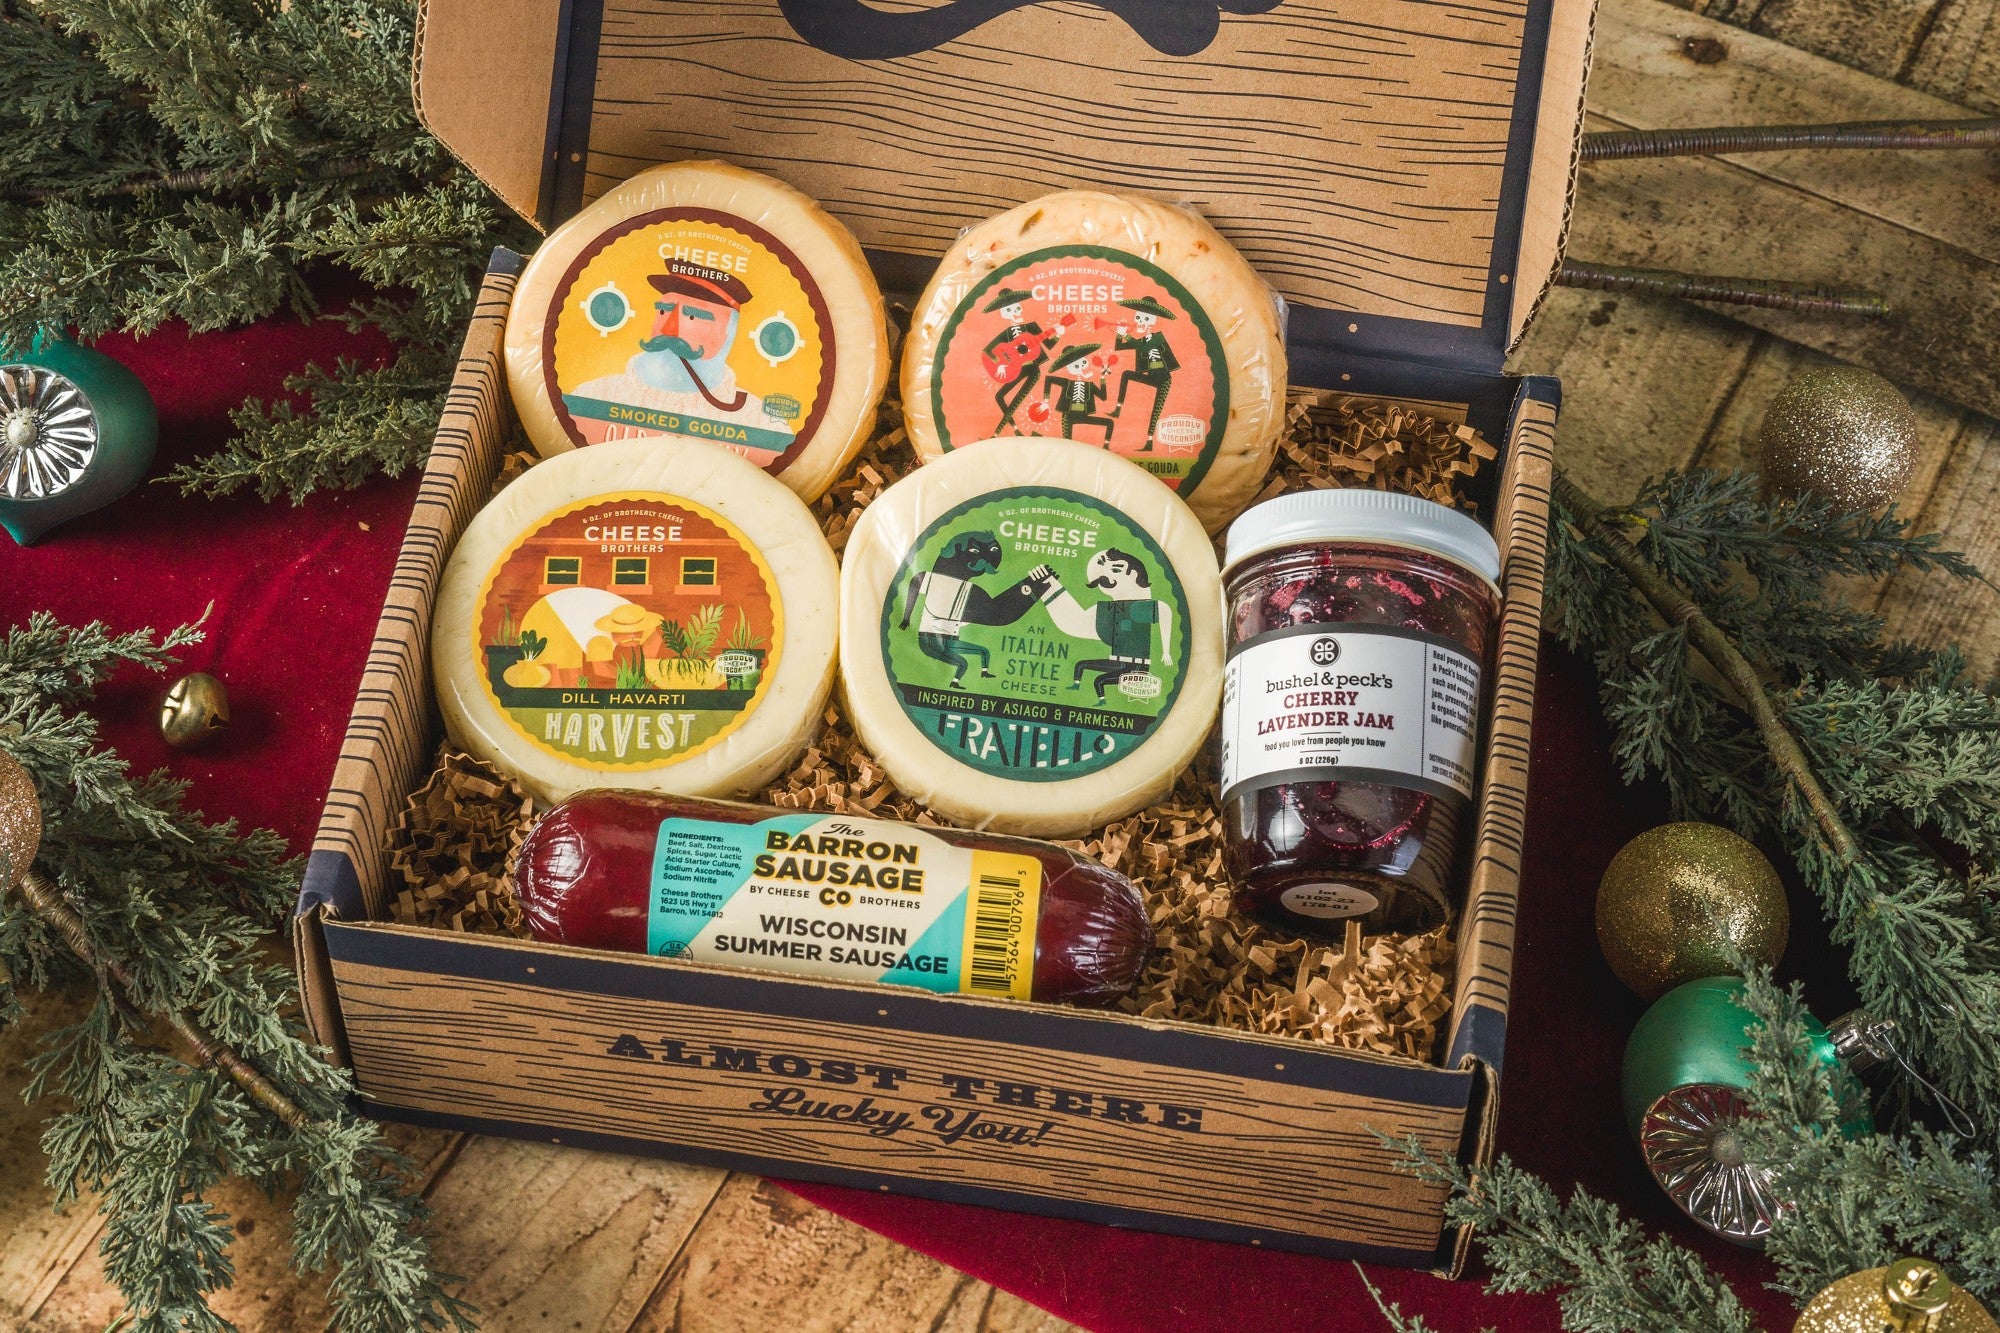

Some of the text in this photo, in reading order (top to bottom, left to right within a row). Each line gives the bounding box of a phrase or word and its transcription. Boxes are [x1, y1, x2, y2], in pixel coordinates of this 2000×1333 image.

[688, 231, 726, 243] BROTHERLY
[728, 240, 752, 255] CHEESE
[658, 243, 748, 272] CHEESE
[672, 265, 729, 281] BROTHERS
[1101, 271, 1125, 282] CHEESE
[1031, 285, 1123, 301] CHEESE
[1048, 304, 1107, 313] BROTHERS
[609, 407, 679, 429] SMOKED
[689, 421, 747, 441] GOUDA
[1162, 433, 1201, 442] WISCONSIN
[1148, 462, 1179, 473] GOUDA
[658, 513, 684, 524] CHEESE
[1032, 508, 1074, 518] BROTHERLY
[1075, 515, 1101, 529] CHEESE
[584, 526, 682, 542] CHEESE
[1000, 521, 1097, 547] CHEESE
[601, 545, 663, 553] BROTHERS
[1015, 542, 1077, 557] BROTHERS
[1027, 626, 1044, 635] AN
[1001, 635, 1068, 659] ITALIAN
[1433, 650, 1445, 661] Real
[1447, 656, 1463, 669] people
[1006, 659, 1061, 681] STYLE
[1439, 665, 1455, 678] Peck's
[1123, 676, 1157, 684] PROUDLY
[1266, 672, 1393, 693] bushel & peck's
[1432, 678, 1445, 687] each
[1447, 682, 1456, 691] and
[1001, 680, 1057, 696] CHEESE
[1123, 686, 1157, 695] WISCONSIN
[562, 693, 685, 705] DILL HAVARTI
[1284, 691, 1359, 709] CHERRY
[918, 691, 1134, 730] INSPIRED BY ASIAGO & PARMESAN
[1437, 705, 1456, 718] organic
[1258, 712, 1394, 736] LAVENDER JAM
[1431, 714, 1441, 725] like
[545, 713, 696, 758] HARVEST
[938, 714, 1116, 768] FRATELLO
[1265, 743, 1277, 751] food
[1279, 741, 1289, 750] you
[1325, 736, 1349, 746] people
[1351, 738, 1364, 746] you
[1367, 737, 1385, 747] know
[1315, 756, 1338, 765] (226g)
[669, 832, 723, 842] INGREDIENTS:
[822, 824, 865, 837] The
[667, 847, 692, 856] Spices,
[695, 850, 717, 858] Sugar,
[707, 843, 741, 852] Dextrose,
[766, 830, 919, 865] BARRON
[664, 864, 734, 877] Sodium Ascorbate,
[712, 860, 740, 870] Culture,
[663, 873, 717, 884] Sodium Nitrite
[753, 854, 925, 893] SAUSAGE
[661, 897, 677, 905] 1623
[662, 889, 722, 900] Cheese Brothers
[768, 887, 810, 898] CHEESE
[860, 896, 920, 909] BROTHERS
[660, 906, 687, 915] Barron,
[702, 910, 723, 918] 54812
[1010, 891, 1024, 932] 00796
[760, 914, 907, 946] WISCONSIN
[714, 935, 822, 961] SUMMER
[830, 947, 949, 974] SAUSAGE
[1006, 940, 1019, 980] 57564
[606, 1033, 1203, 1133] ALMOST THERE
[749, 1086, 1056, 1148] Lucky You!
